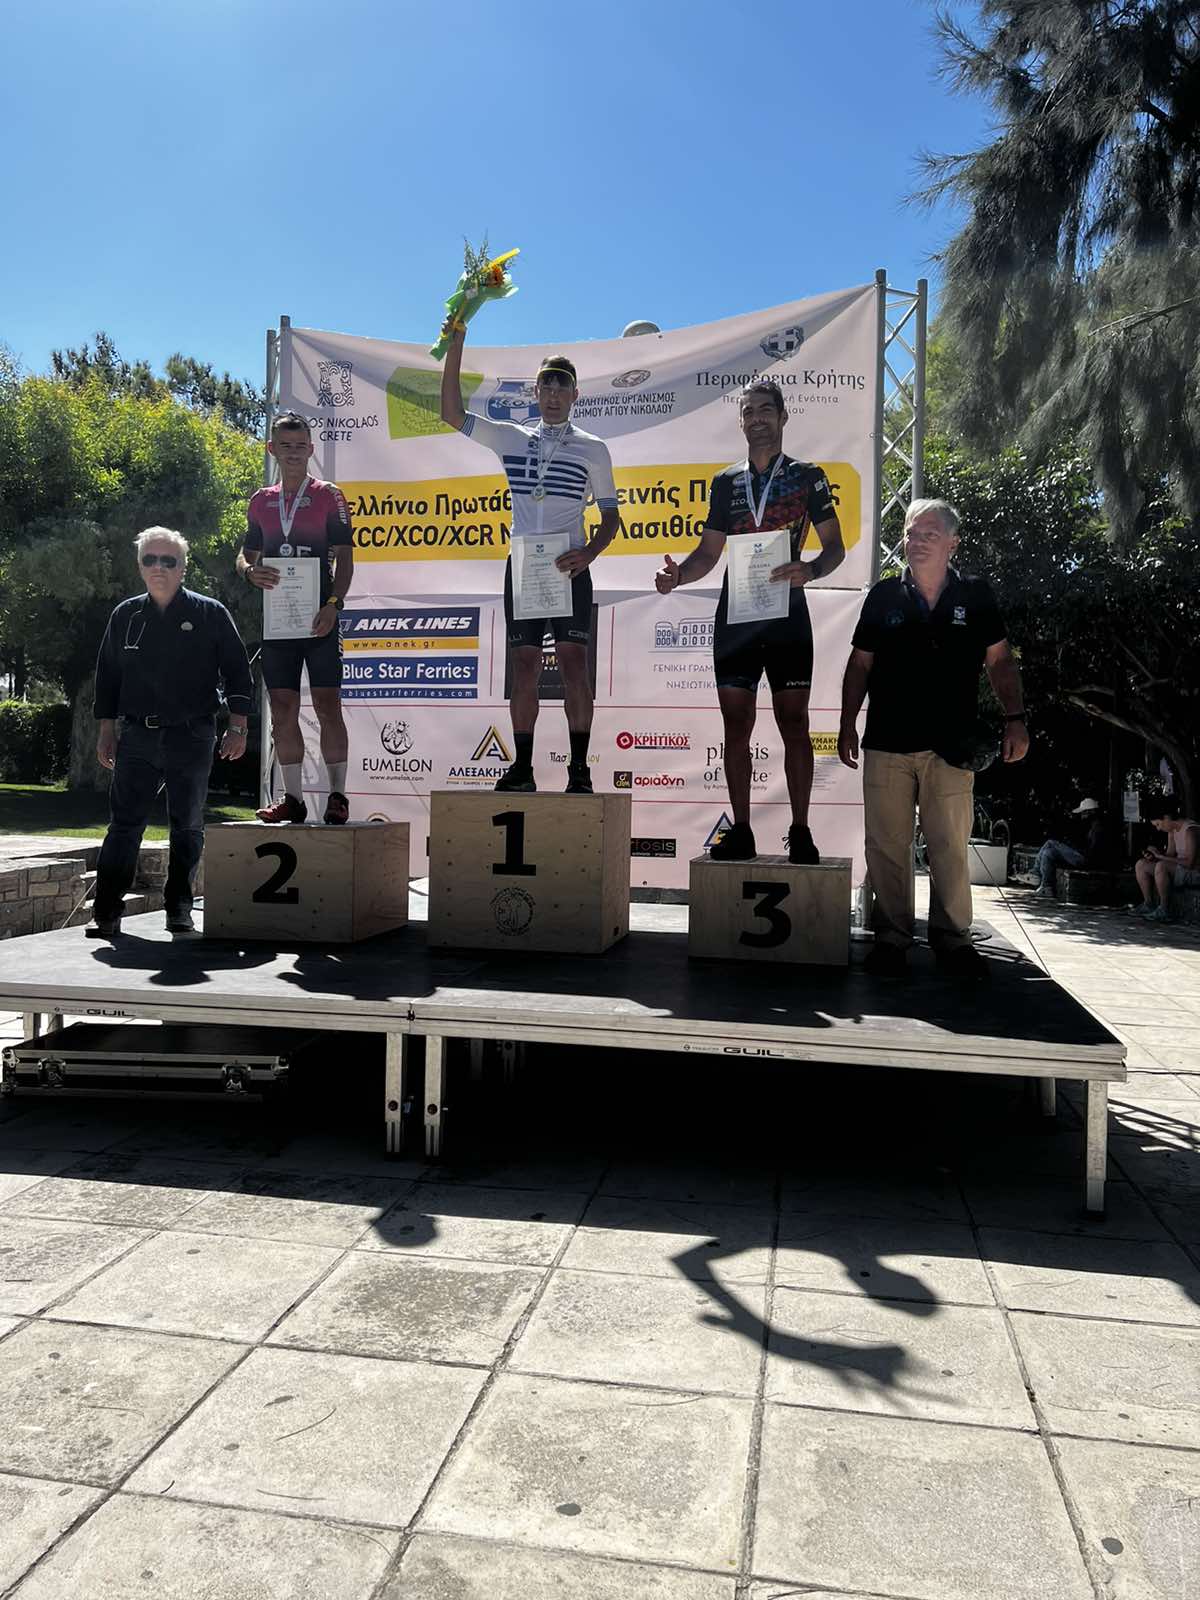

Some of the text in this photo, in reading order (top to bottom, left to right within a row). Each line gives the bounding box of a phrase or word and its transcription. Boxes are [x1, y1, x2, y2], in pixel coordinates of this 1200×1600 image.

[803, 369, 865, 390] Κρήτης
[621, 391, 676, 404] ΟΡΓΑΝΙΣΜΟΣ
[573, 403, 673, 418] ΔΗΜΟΥ ΑΓΙΟΥ ΝΙΚΟΛΑΟΥ
[326, 415, 379, 429] NIKOLAOS
[319, 430, 353, 441] CRETE
[616, 480, 681, 508] εινής
[348, 494, 428, 516] ελλήνιο
[435, 488, 512, 520] Πρωτάθ
[613, 514, 706, 539] Λασιθίο
[353, 616, 473, 631] ANEK LINES
[342, 662, 471, 679] Blue Star Ferries
[653, 664, 687, 673] ΓΕΝΙΚΗ
[634, 735, 689, 746] ΚΡΗΤΙΚΟΣ
[362, 758, 433, 772] EUMELON
[703, 767, 722, 781] of
[491, 811, 537, 876] 1
[252, 841, 299, 904] 2
[738, 881, 792, 948] 3
[86, 1008, 136, 1017] GUIL
[723, 1046, 785, 1058] GUIL
